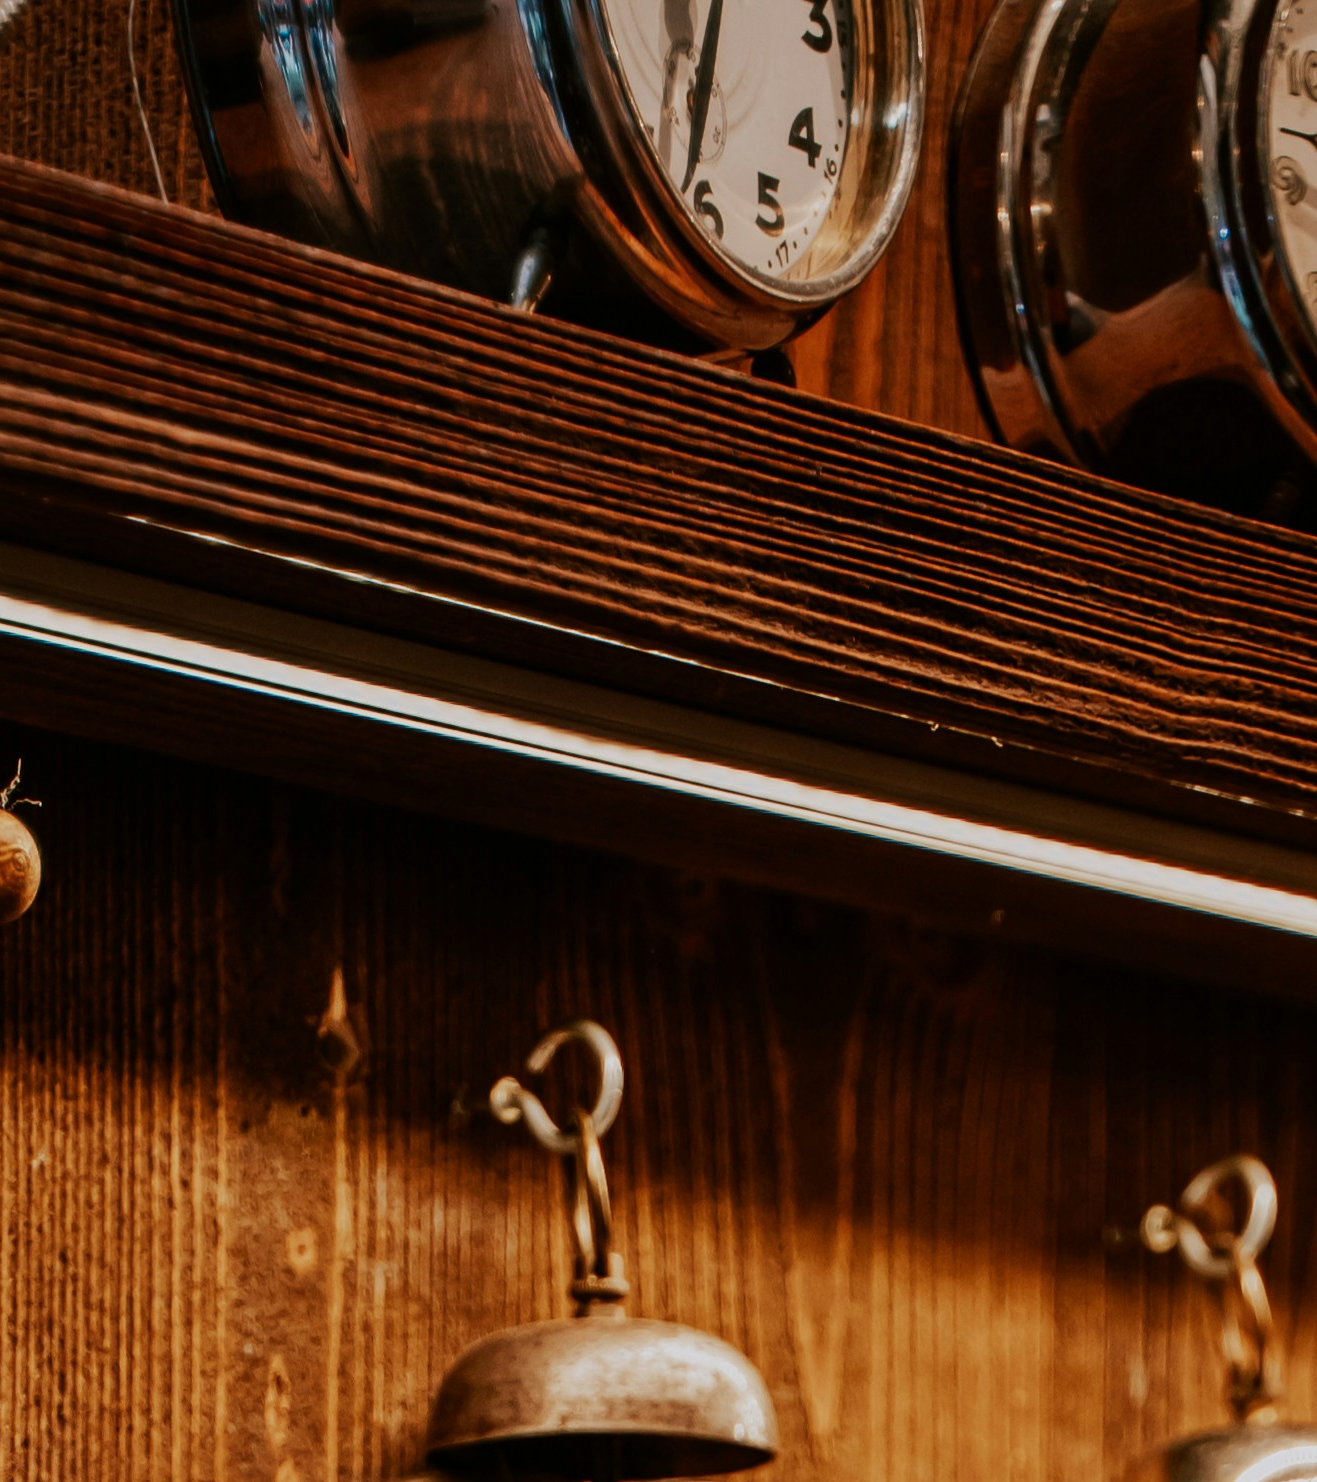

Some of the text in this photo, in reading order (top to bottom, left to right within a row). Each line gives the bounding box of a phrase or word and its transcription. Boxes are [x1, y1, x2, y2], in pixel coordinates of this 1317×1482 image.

[789, 107, 822, 168] 4
[756, 171, 784, 237] 5
[1272, 156, 1307, 206] 9
[775, 241, 790, 267] 17
